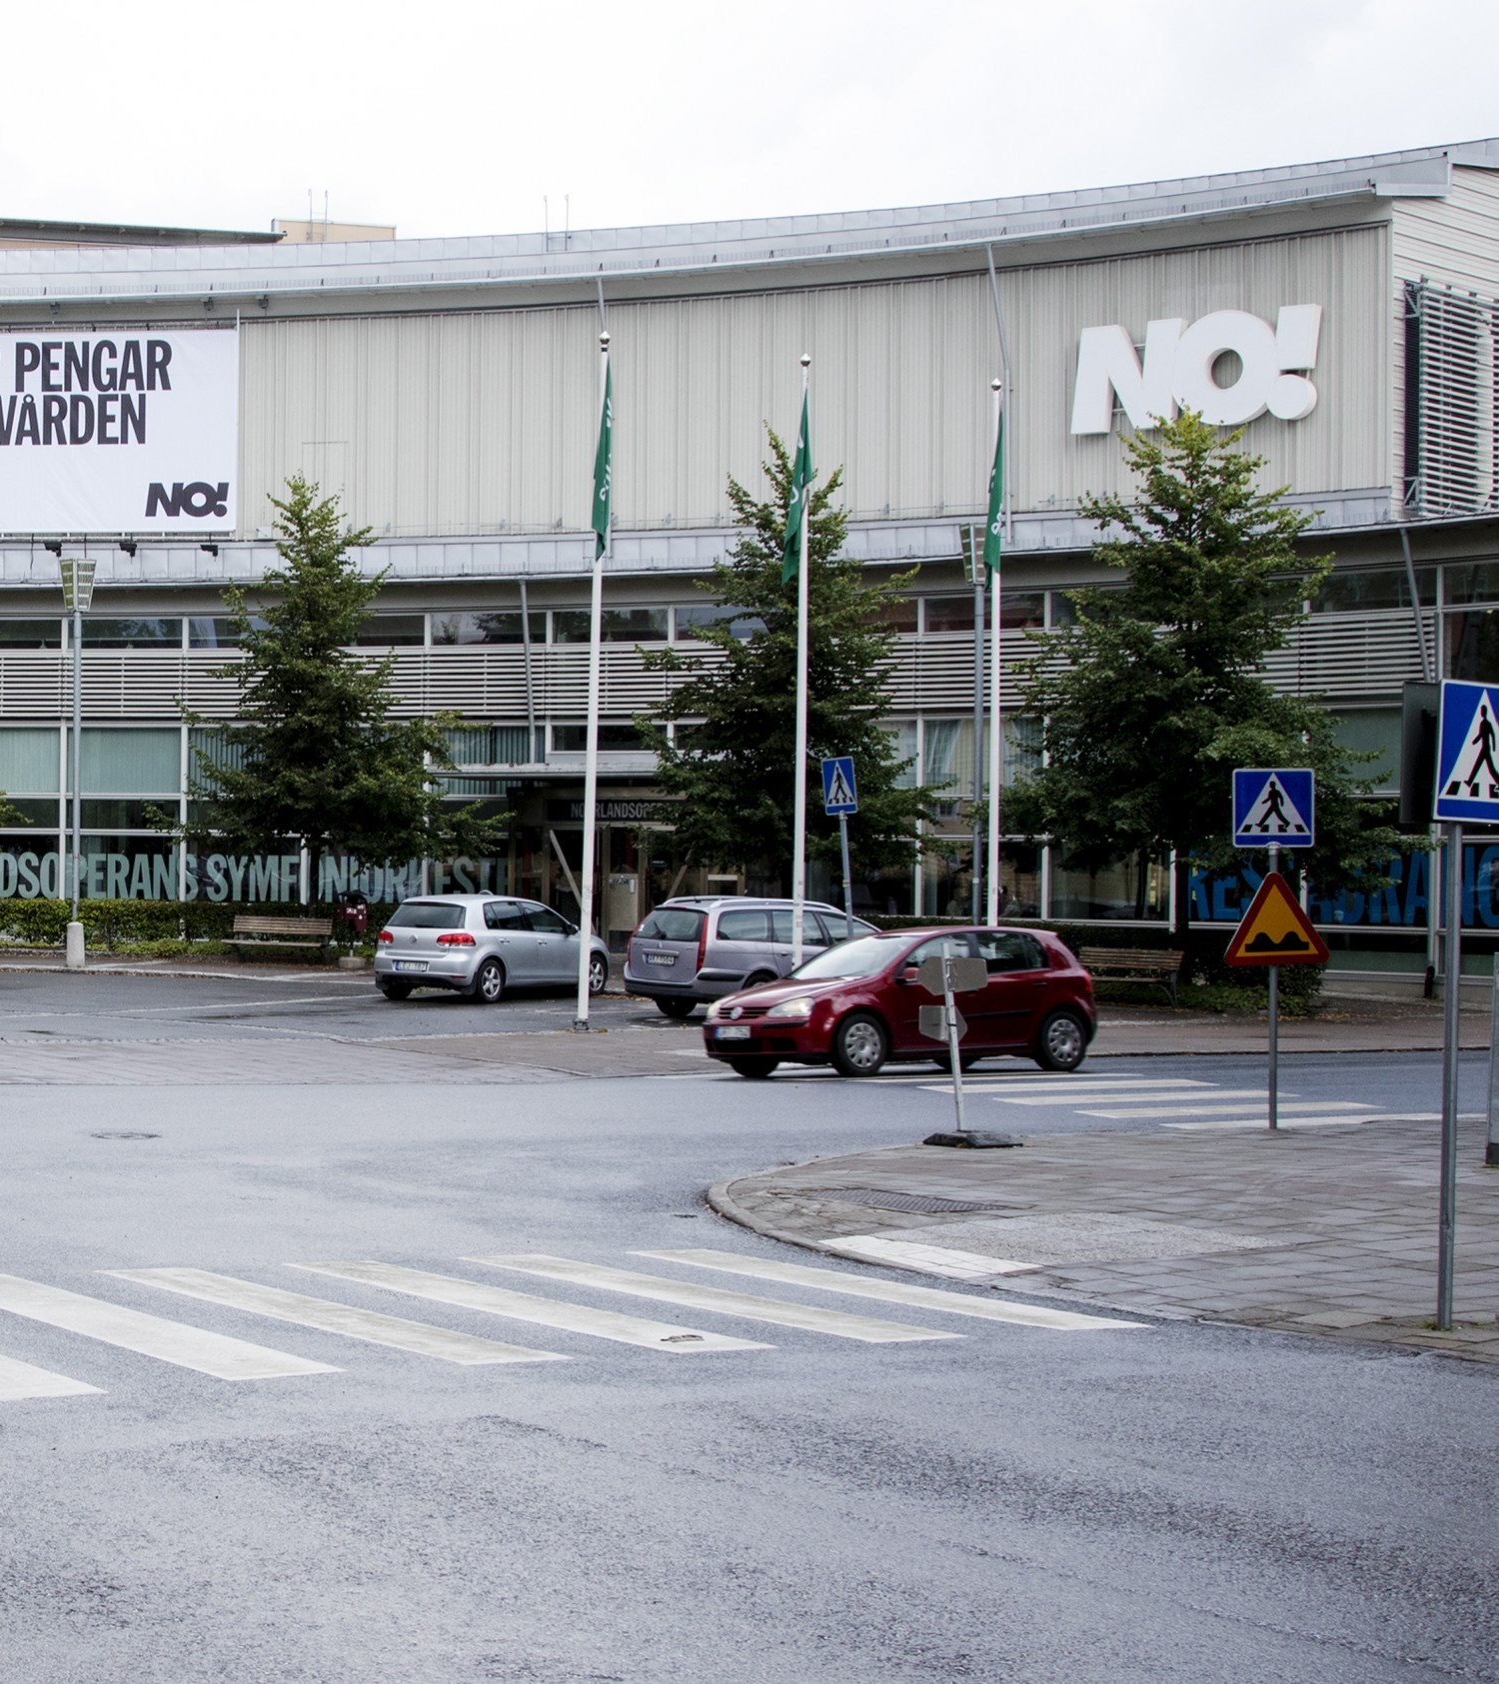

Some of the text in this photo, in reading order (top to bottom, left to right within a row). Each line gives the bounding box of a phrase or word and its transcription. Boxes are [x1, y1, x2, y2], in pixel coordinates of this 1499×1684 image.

[15, 339, 173, 393] PENGAR
[1070, 303, 1322, 435] NO!
[144, 481, 230, 518] NO!
